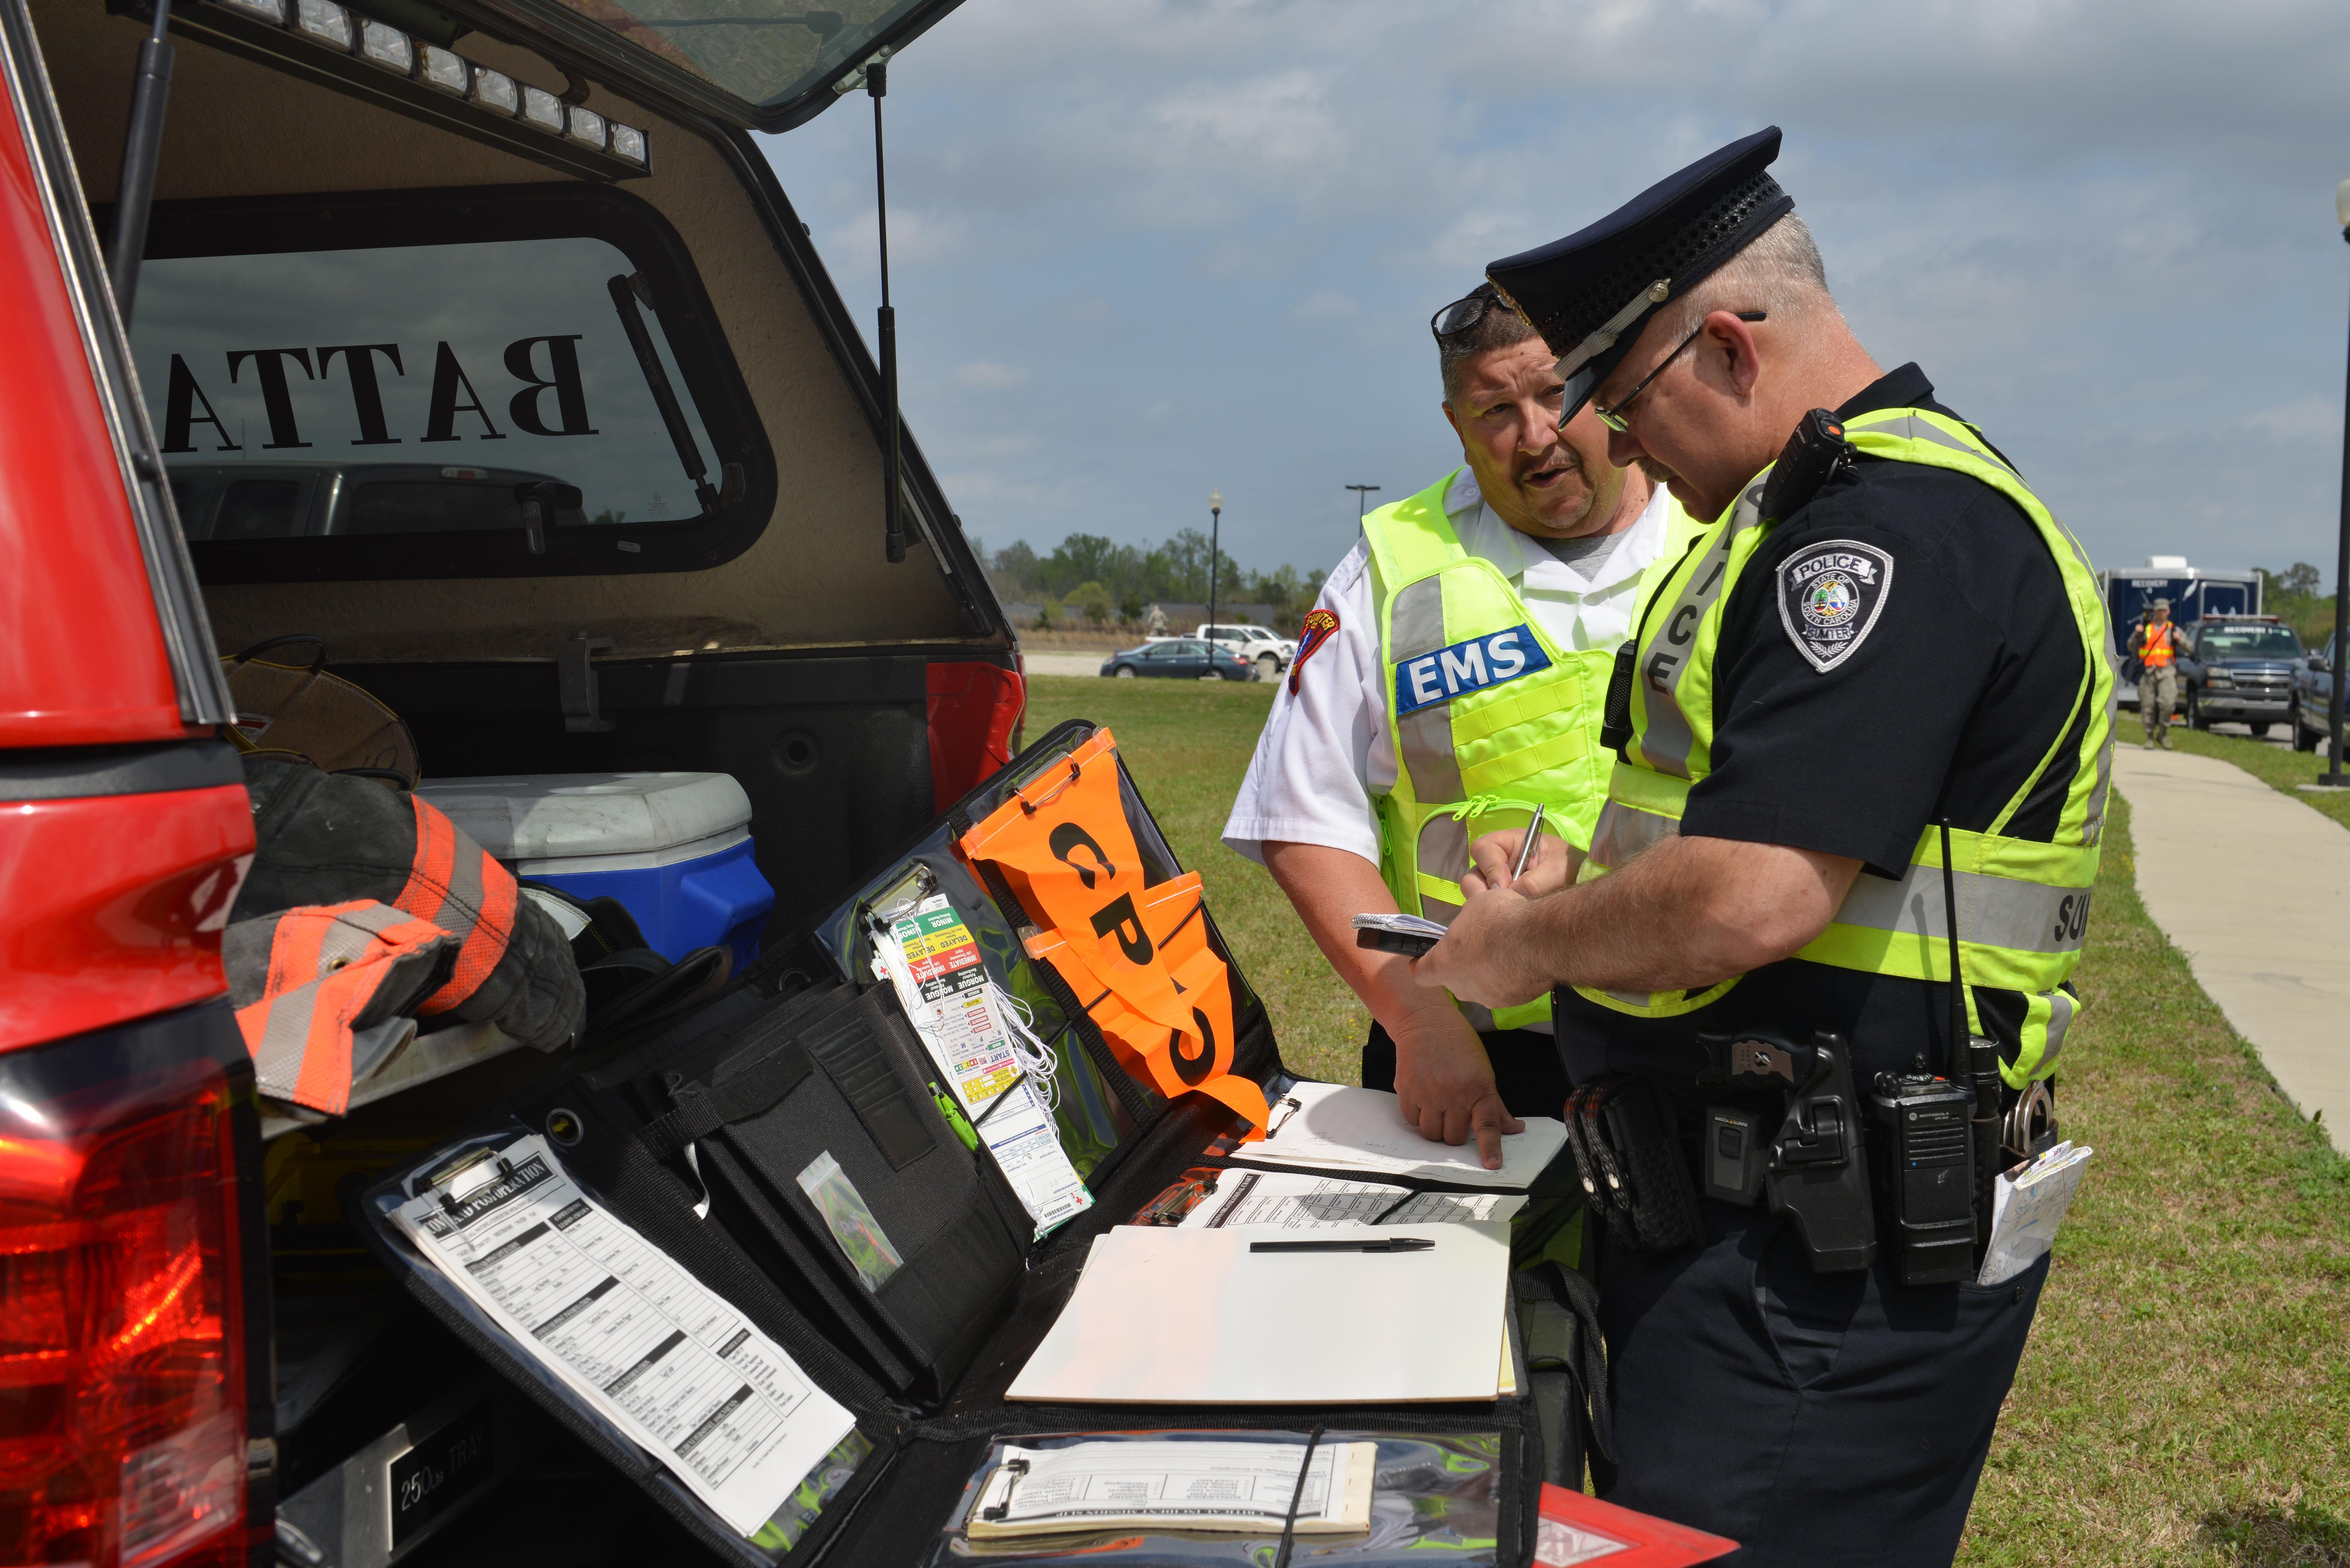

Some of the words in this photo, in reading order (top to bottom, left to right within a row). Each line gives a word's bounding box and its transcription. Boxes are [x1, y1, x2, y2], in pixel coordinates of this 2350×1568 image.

[1799, 554, 1862, 579] POLICE
[1812, 573, 1837, 589] STATE
[1839, 575, 1851, 585] OF
[1803, 602, 1821, 624] SOUTH
[1823, 599, 1858, 624] CAROLINA
[1807, 628, 1849, 639] SUMTER
[1408, 632, 1526, 704] EMS
[931, 916, 953, 928] MINOR
[940, 935, 967, 948] DELAYED
[948, 954, 977, 968] IMMEDIATE
[949, 952, 966, 961] Threatening
[957, 974, 984, 989] MORGUE
[968, 1008, 984, 1017] IMMEDIATE
[971, 1016, 987, 1024] IMMEDIATE
[974, 1023, 990, 1032] IMMEDIATE
[989, 1050, 1010, 1062] START
[1239, 1175, 1255, 1187] CHART
[421, 1204, 476, 1236] COMAND
[448, 1427, 484, 1474] TRAY
